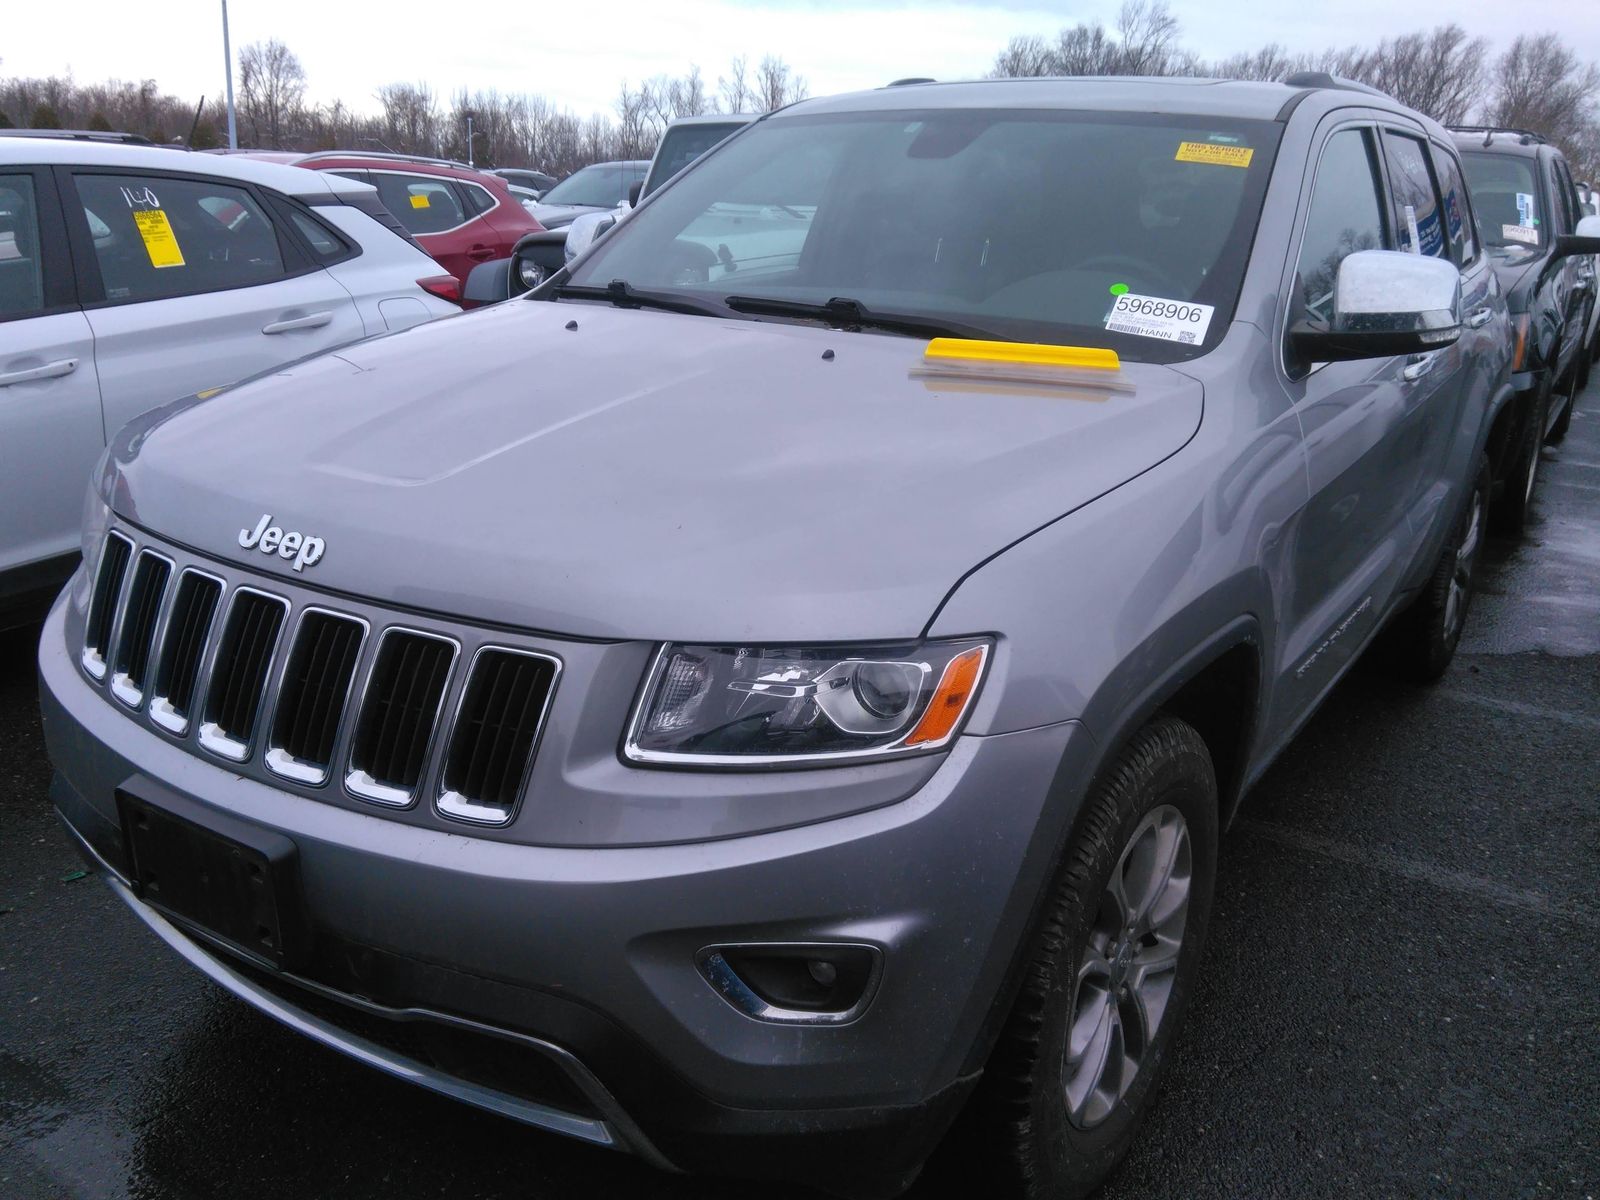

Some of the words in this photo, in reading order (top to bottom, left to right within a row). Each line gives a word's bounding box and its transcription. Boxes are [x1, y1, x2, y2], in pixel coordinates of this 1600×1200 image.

[1209, 145, 1248, 153] VEHICLE
[1116, 296, 1203, 323] 5968906
[1140, 328, 1173, 339] HANN
[238, 513, 326, 572] Jeep
